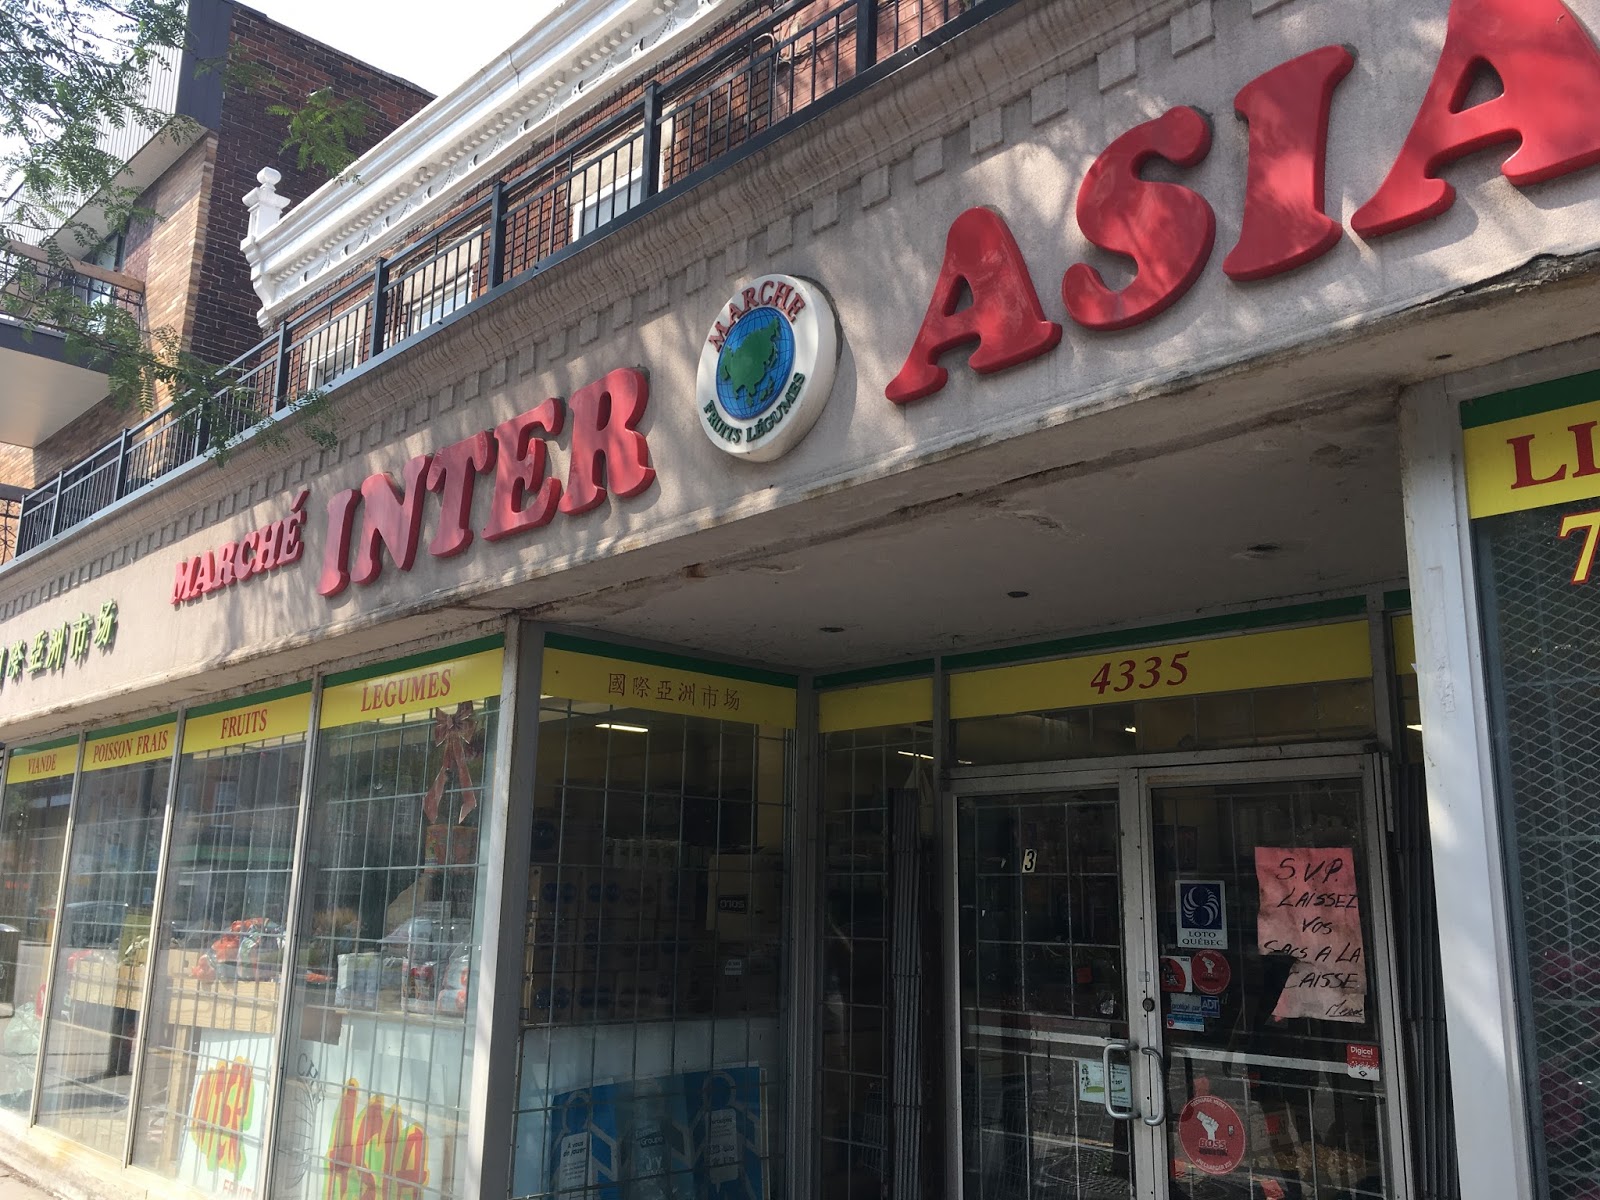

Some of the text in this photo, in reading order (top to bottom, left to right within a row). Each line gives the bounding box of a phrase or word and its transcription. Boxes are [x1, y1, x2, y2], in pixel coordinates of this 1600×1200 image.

[170, 0, 1600, 605] MARCHÉ INTER ASIA
[708, 280, 805, 353] MARCHE
[703, 372, 805, 443] FRUITS LÉGUMES
[1090, 650, 1190, 695] 4335
[360, 668, 452, 712] LEGUMES
[608, 672, 741, 712] 國際亞洲市场
[220, 708, 268, 740] FRUITS
[92, 730, 169, 764] POISSON FRAIS
[27, 753, 57, 775] VIANDE
[1025, 850, 1036, 872] 3
[1182, 937, 1224, 947] QUÉBEC
[1188, 931, 1217, 939] LOTO
[1335, 942, 1361, 963] LA
[1201, 999, 1218, 1010] ADT
[1350, 1046, 1373, 1056] Digicel
[1199, 1138, 1227, 1150] BOSS
